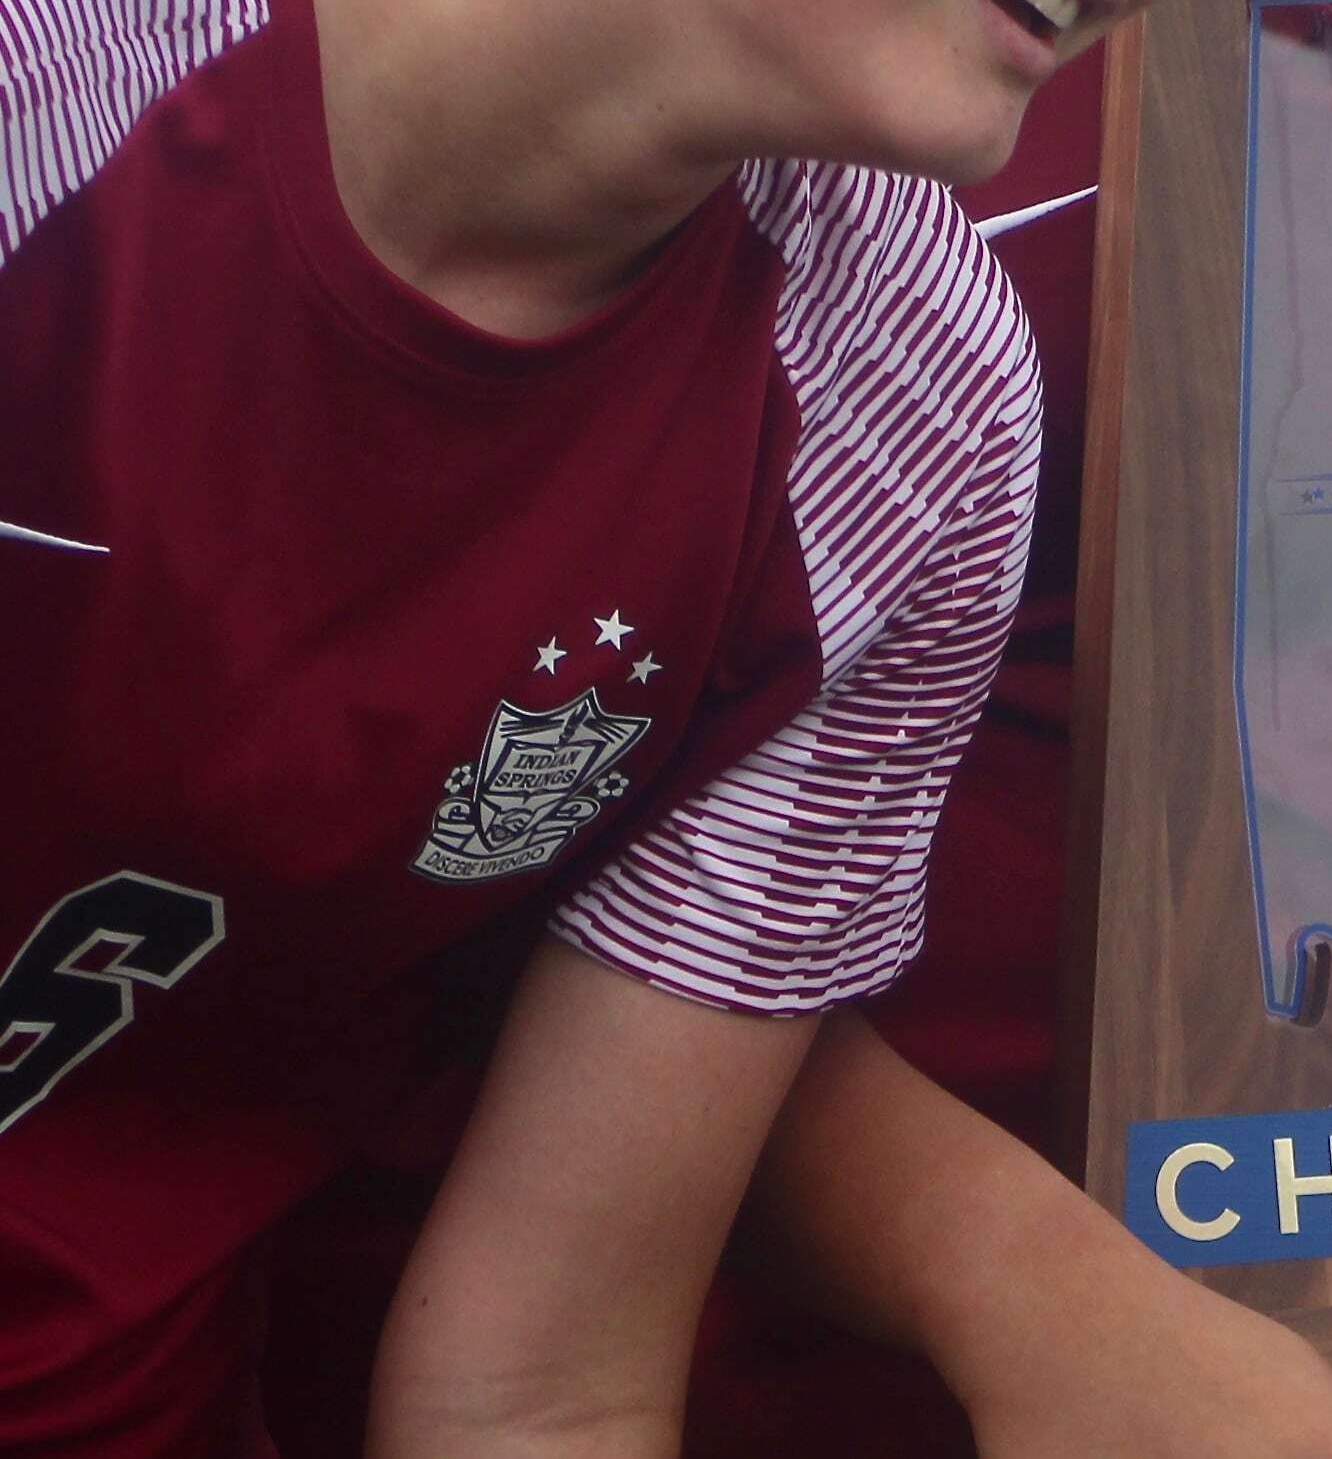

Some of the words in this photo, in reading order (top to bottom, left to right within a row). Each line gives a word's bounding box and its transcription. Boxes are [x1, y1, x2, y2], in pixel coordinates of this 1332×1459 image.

[513, 750, 582, 770] INDIAN
[494, 769, 578, 788] SPRINGS
[425, 850, 477, 876] DISCERE
[478, 846, 545, 873] VIVENDO
